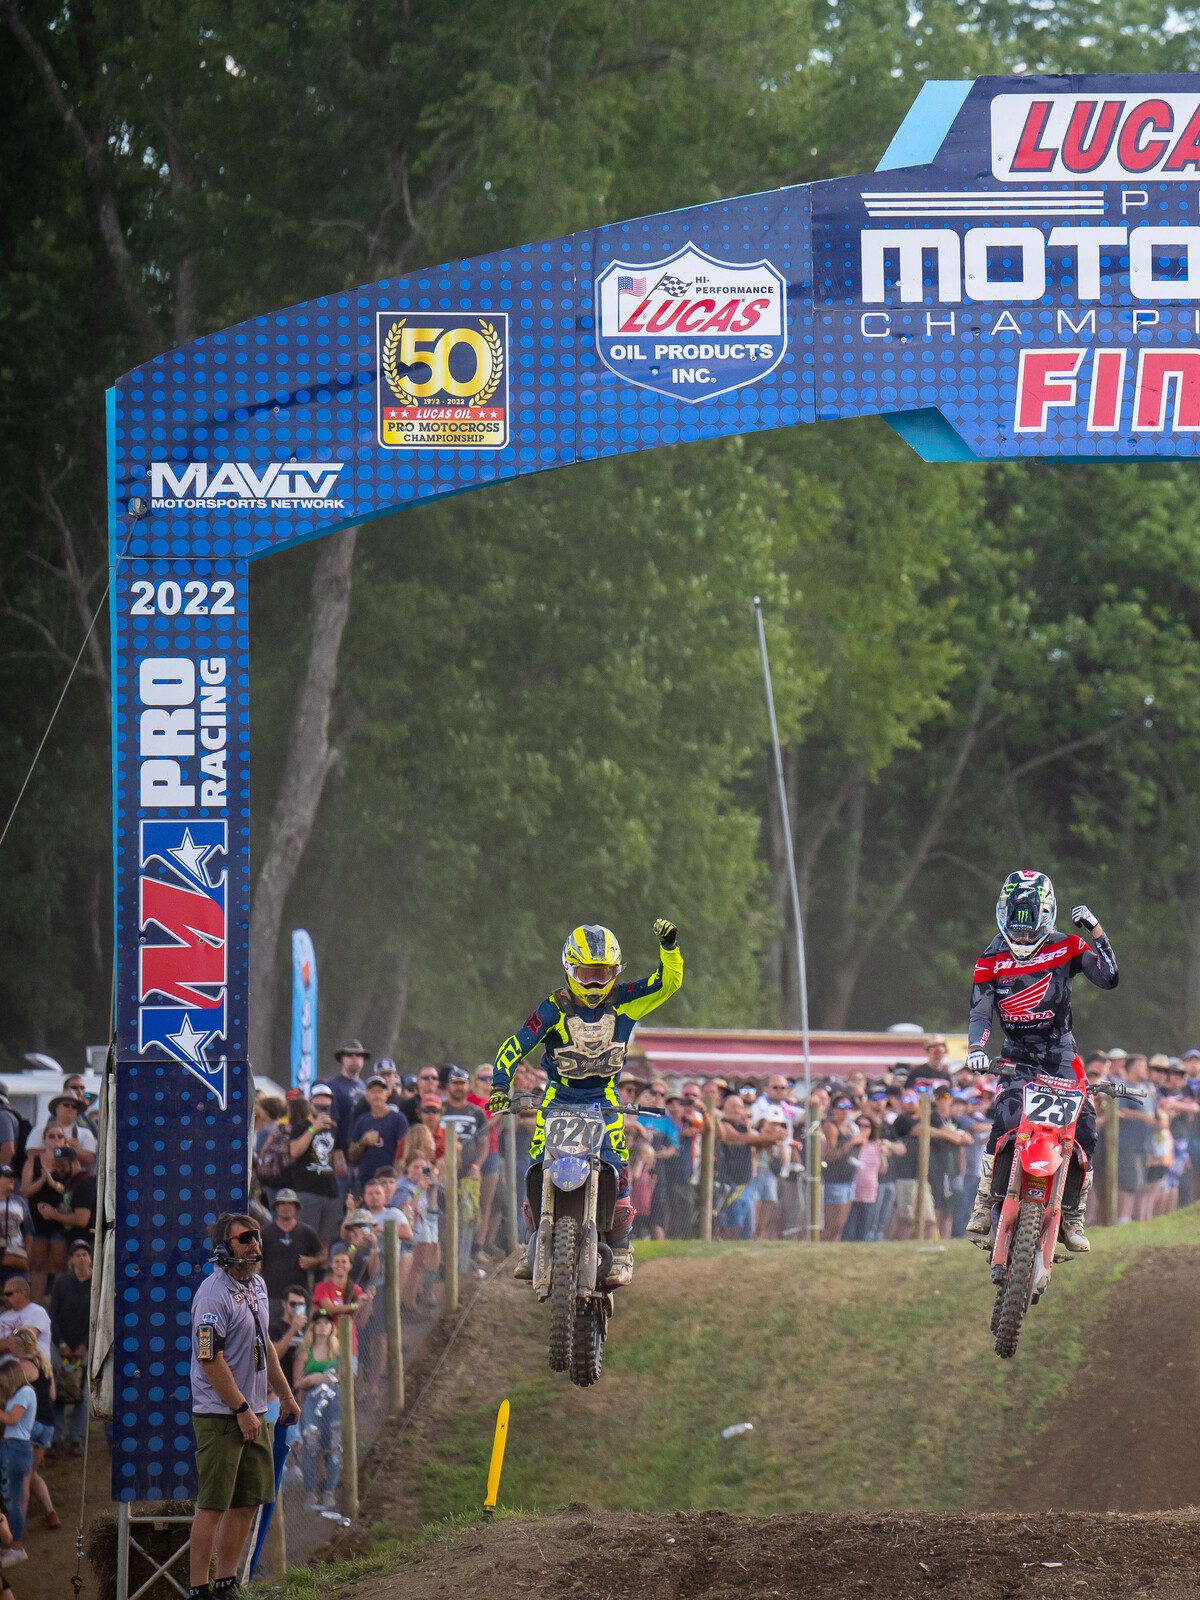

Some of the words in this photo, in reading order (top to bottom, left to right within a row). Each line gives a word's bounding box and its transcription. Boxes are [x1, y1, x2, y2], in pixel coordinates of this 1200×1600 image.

[695, 276, 710, 284] HI-
[695, 286, 774, 294] PERFORMANCE
[619, 298, 770, 333] LUCAS
[397, 328, 493, 398] 50
[610, 345, 647, 360] OIL
[655, 344, 774, 360] PRODUCTS
[416, 409, 452, 419] LUCAS
[454, 409, 472, 419] OIL
[387, 422, 415, 432] PRO
[419, 422, 500, 432] MOTOCROSS
[403, 434, 485, 442] CHAMPIONSHIP
[151, 462, 345, 498] MAVTV
[151, 499, 267, 509] MOTORSPORTS
[271, 499, 345, 509] NETWORK
[130, 580, 236, 615] 2022
[139, 657, 196, 807] PRO
[200, 657, 227, 807] RACING
[1001, 1010, 1055, 1022] HONDA
[1026, 1093, 1077, 1127] 23
[546, 1118, 605, 1148] 820
